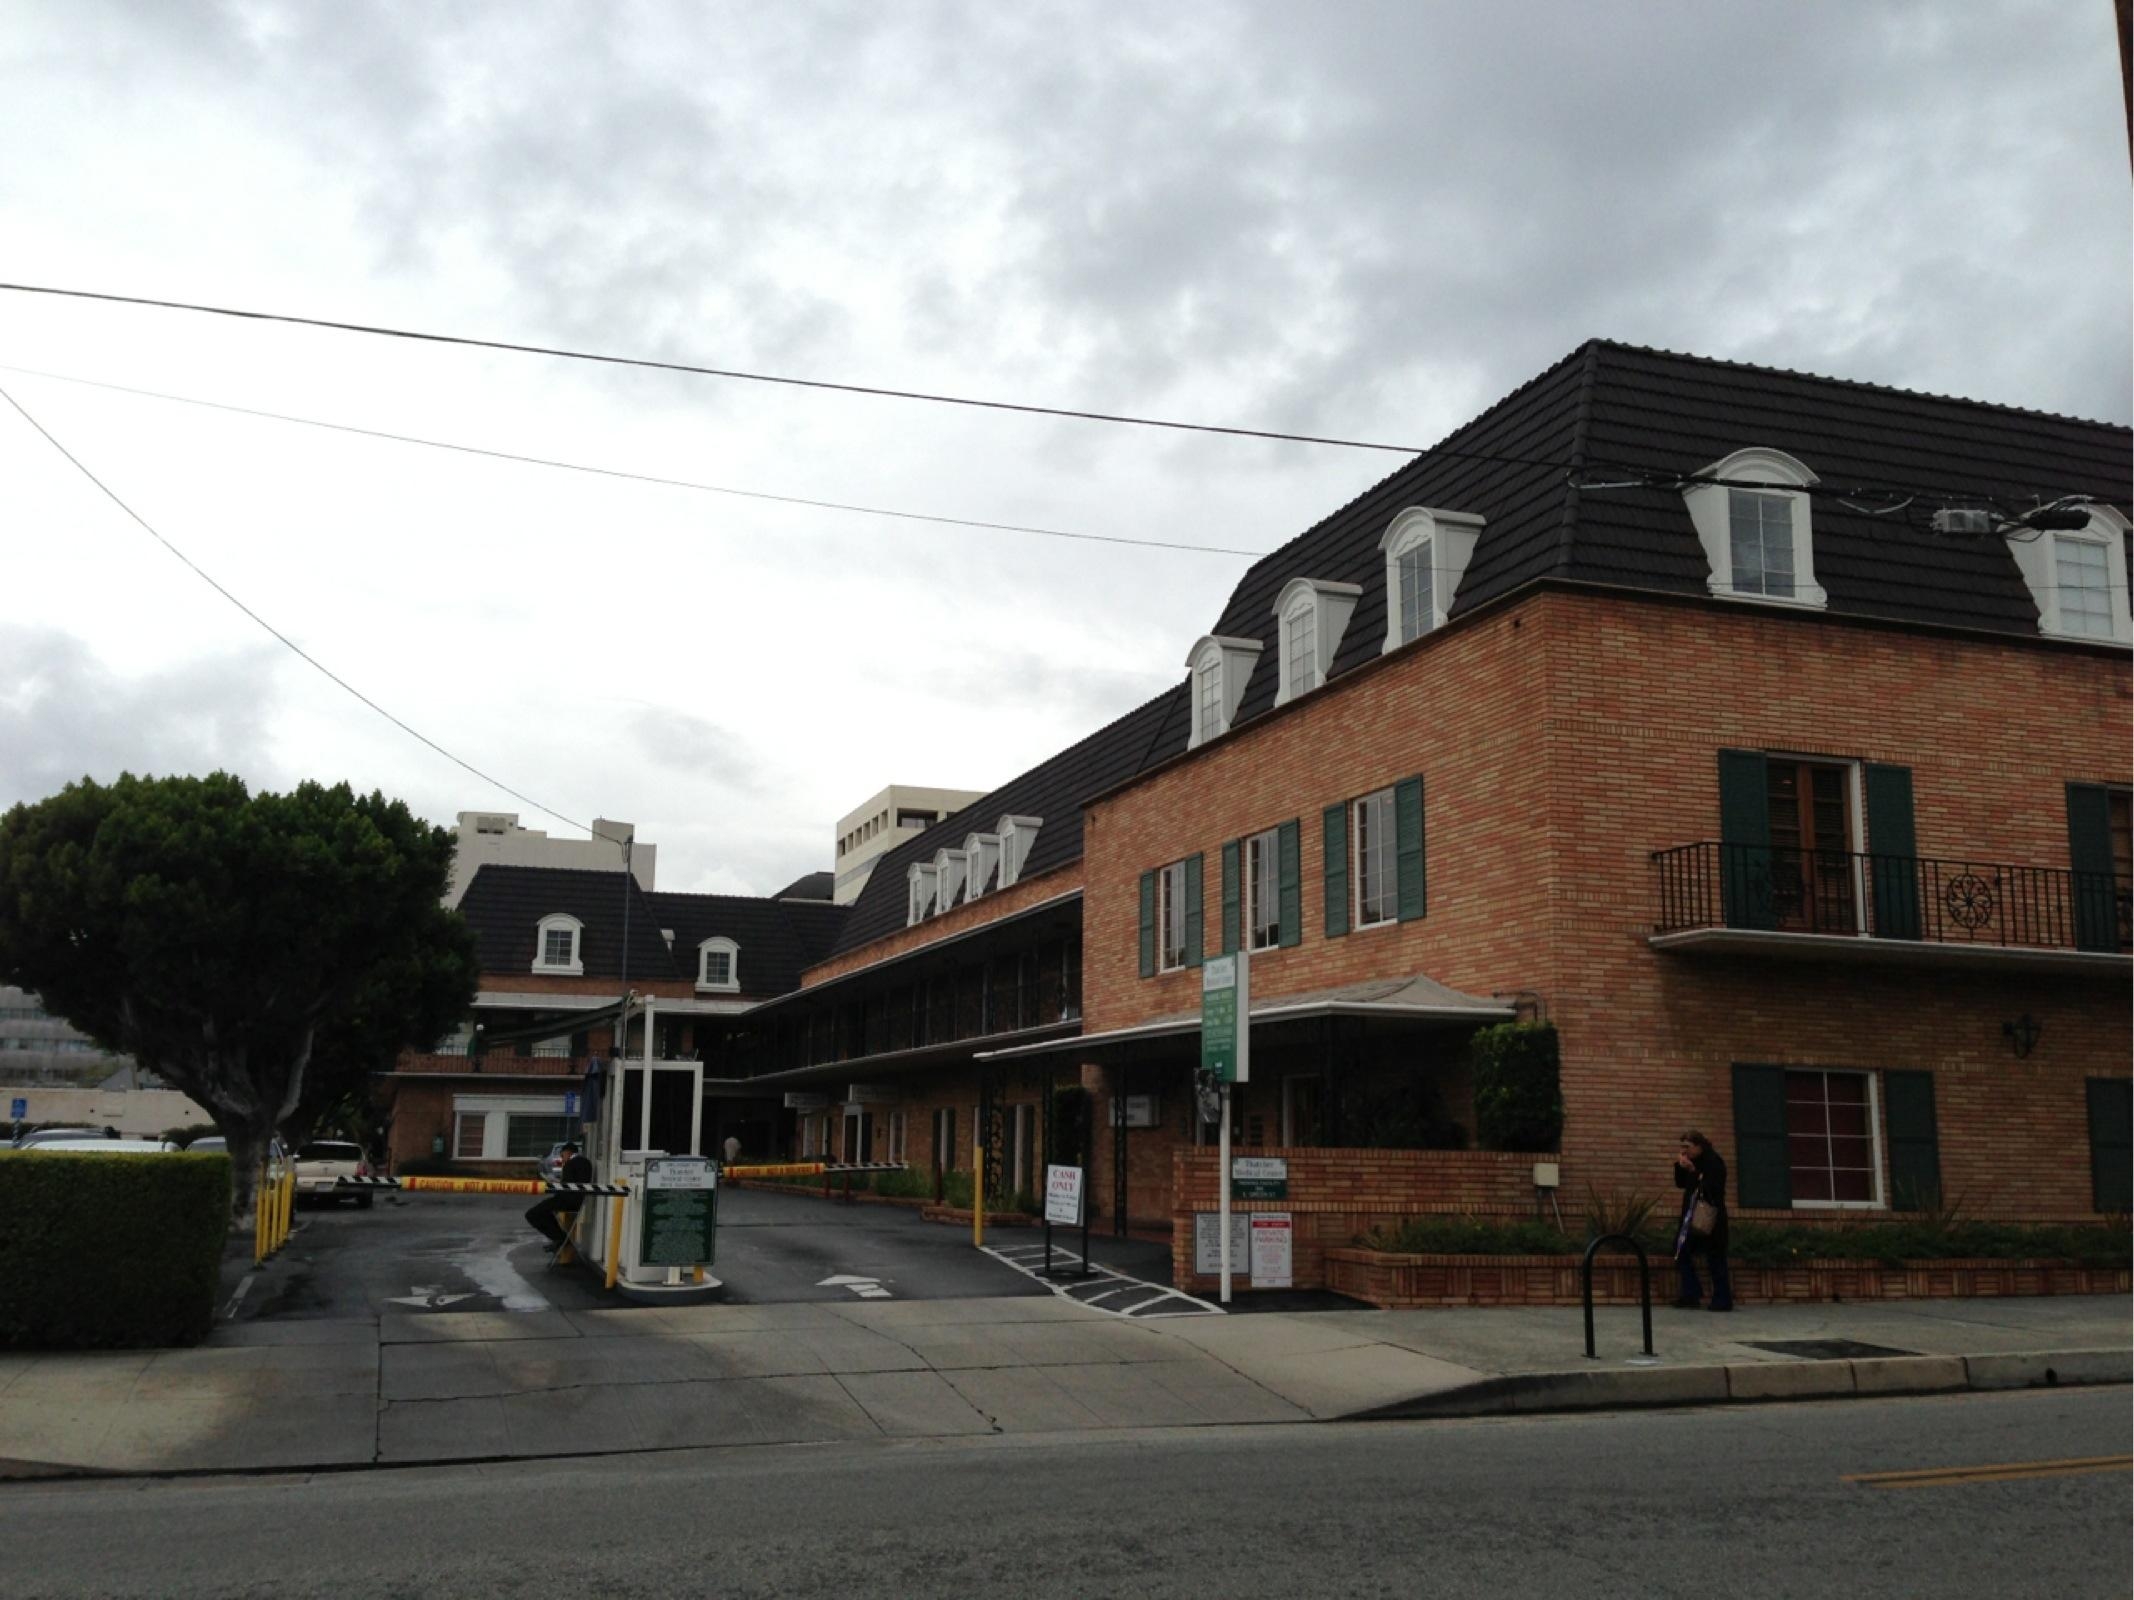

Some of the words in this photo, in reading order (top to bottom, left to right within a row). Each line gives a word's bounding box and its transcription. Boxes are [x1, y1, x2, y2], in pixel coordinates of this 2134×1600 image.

[1053, 1168, 1076, 1180] CASH
[420, 1179, 455, 1192] CAUTION
[463, 1180, 480, 1192] NOT
[481, 1181, 488, 1193] A
[490, 1181, 529, 1194] WALKWAY
[1052, 1180, 1075, 1192] ONLY
